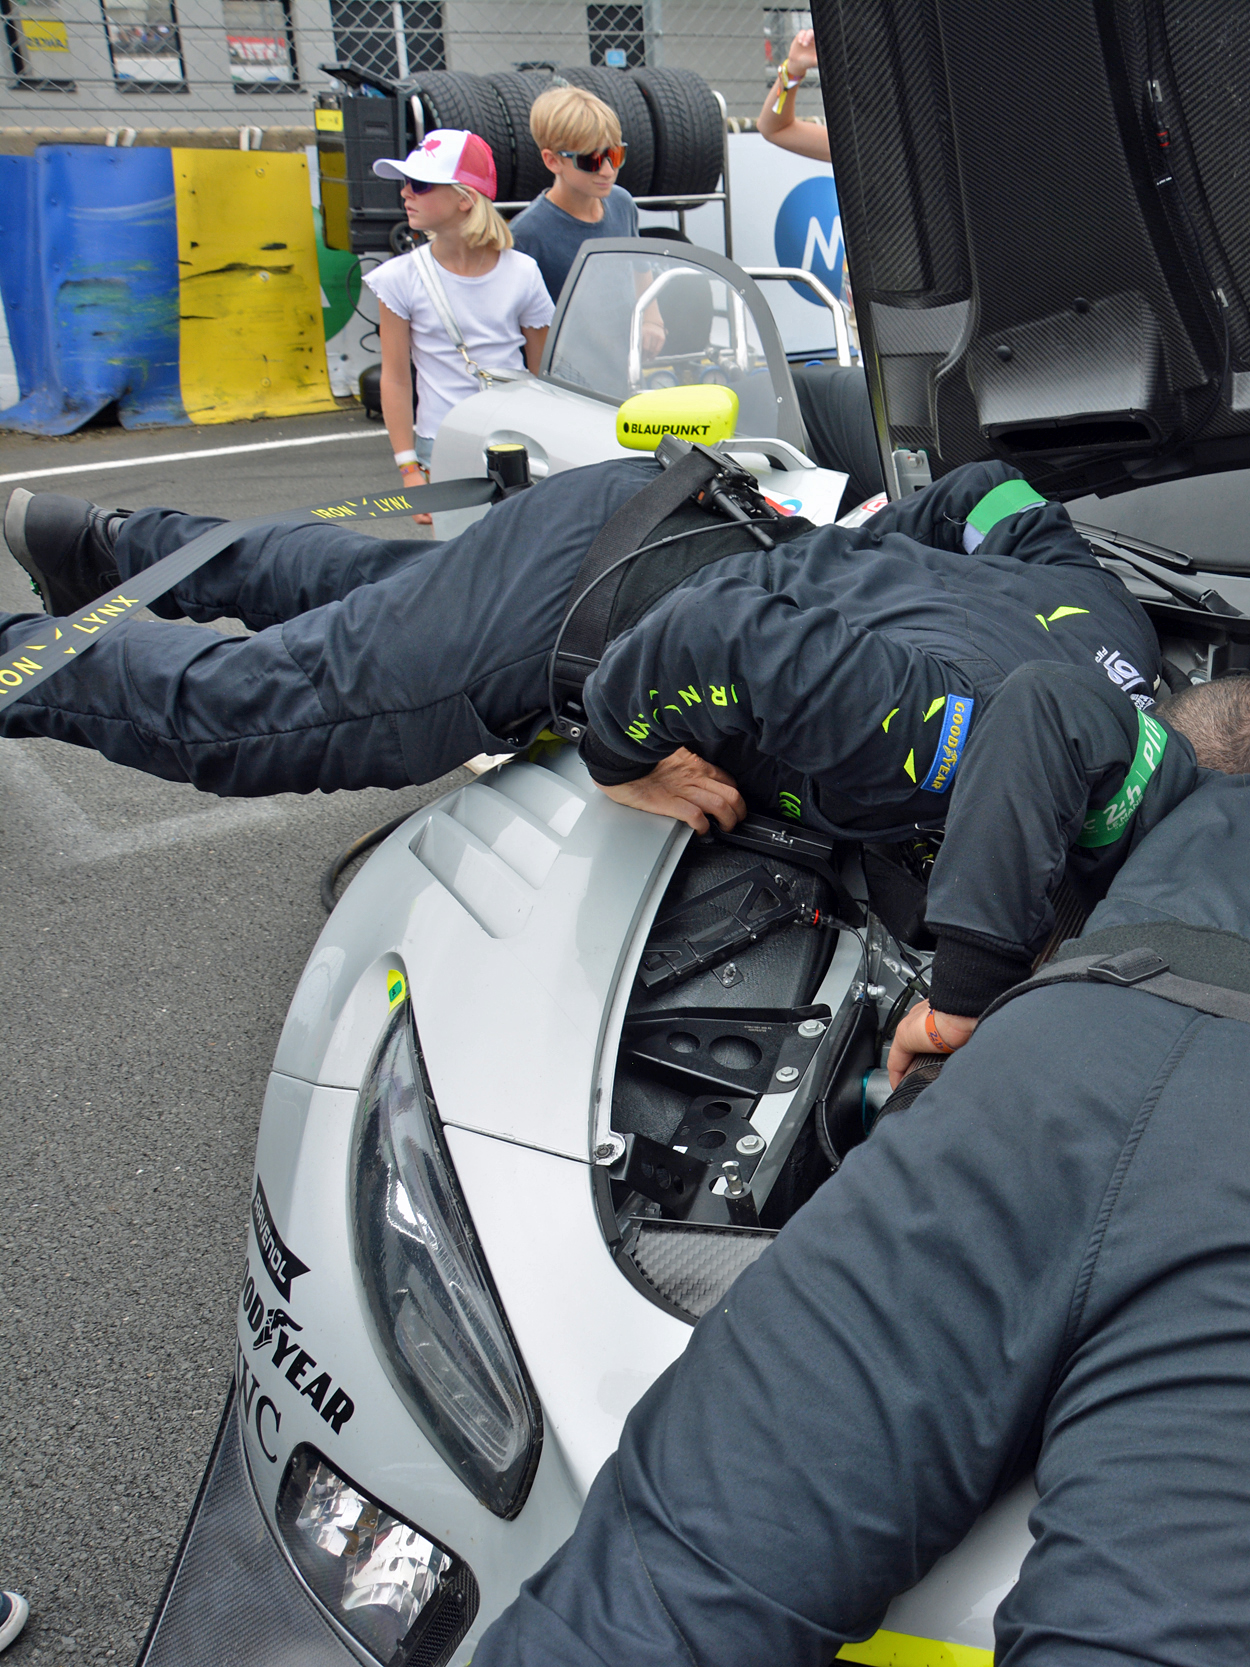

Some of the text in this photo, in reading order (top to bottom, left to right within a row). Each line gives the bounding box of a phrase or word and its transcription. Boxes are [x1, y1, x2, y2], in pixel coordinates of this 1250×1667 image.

[631, 424, 710, 436] BLAUPUNKT
[311, 495, 413, 519] IRON LYNX
[0, 594, 139, 694] ON LYNX
[678, 684, 739, 707] IRN
[931, 701, 965, 790] GOODYEAR
[254, 1192, 287, 1284] RAVENOL
[241, 1257, 354, 1436] OODYEAR
[238, 1337, 281, 1463] WC
